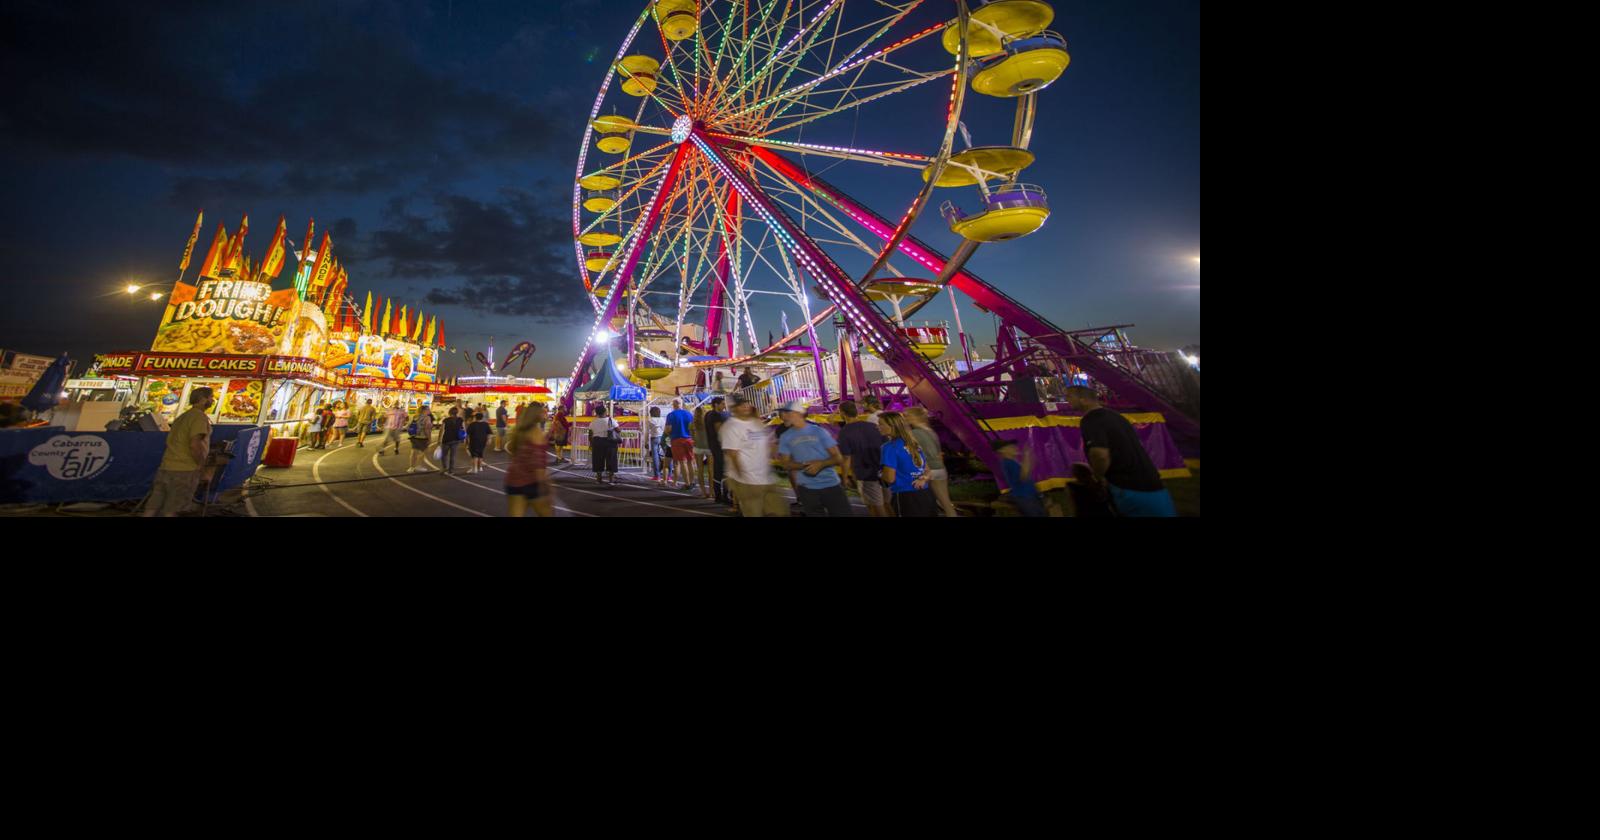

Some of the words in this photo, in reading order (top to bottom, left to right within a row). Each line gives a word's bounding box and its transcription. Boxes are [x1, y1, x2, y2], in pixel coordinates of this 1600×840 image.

[175, 299, 284, 325] DOUGH!
[143, 357, 206, 369] FUNNEL
[208, 359, 257, 370] CAKES
[52, 440, 103, 448] Cabarrus
[60, 448, 104, 478] fair
